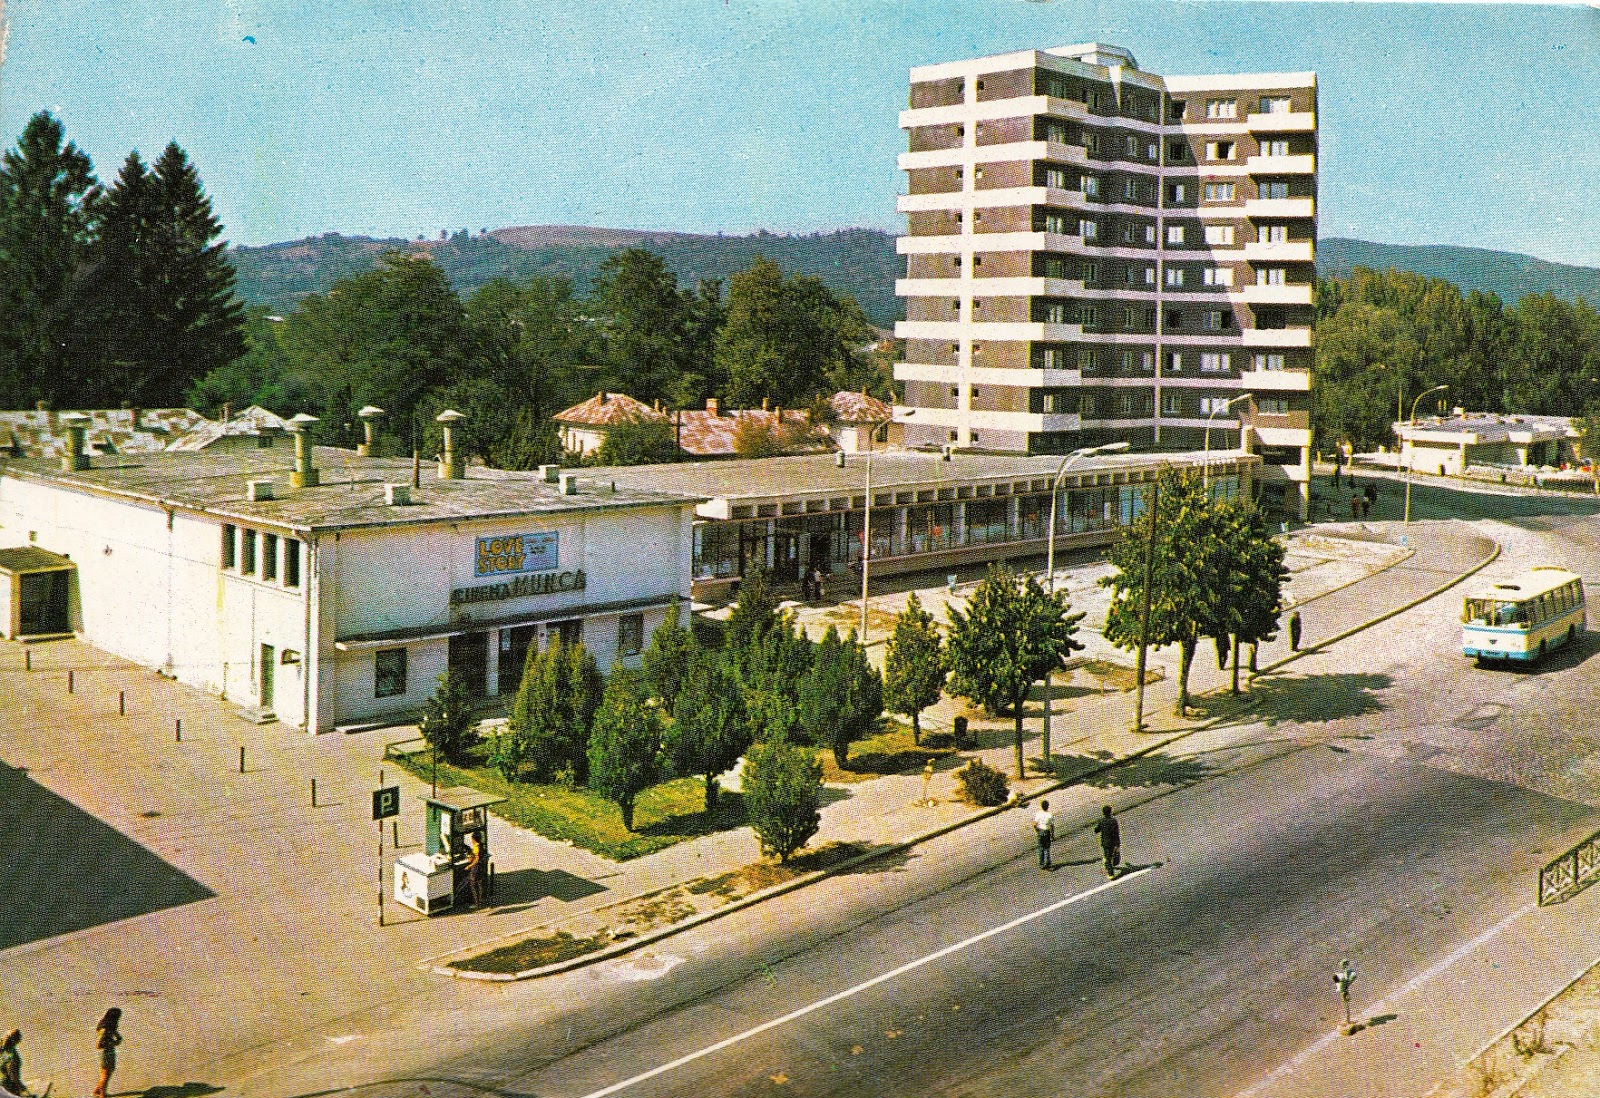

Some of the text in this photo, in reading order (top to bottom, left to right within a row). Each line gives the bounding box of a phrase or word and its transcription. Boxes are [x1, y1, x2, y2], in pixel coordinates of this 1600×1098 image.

[478, 537, 524, 556] LOVE
[478, 554, 526, 574] STORY
[450, 584, 510, 603] CINEMA
